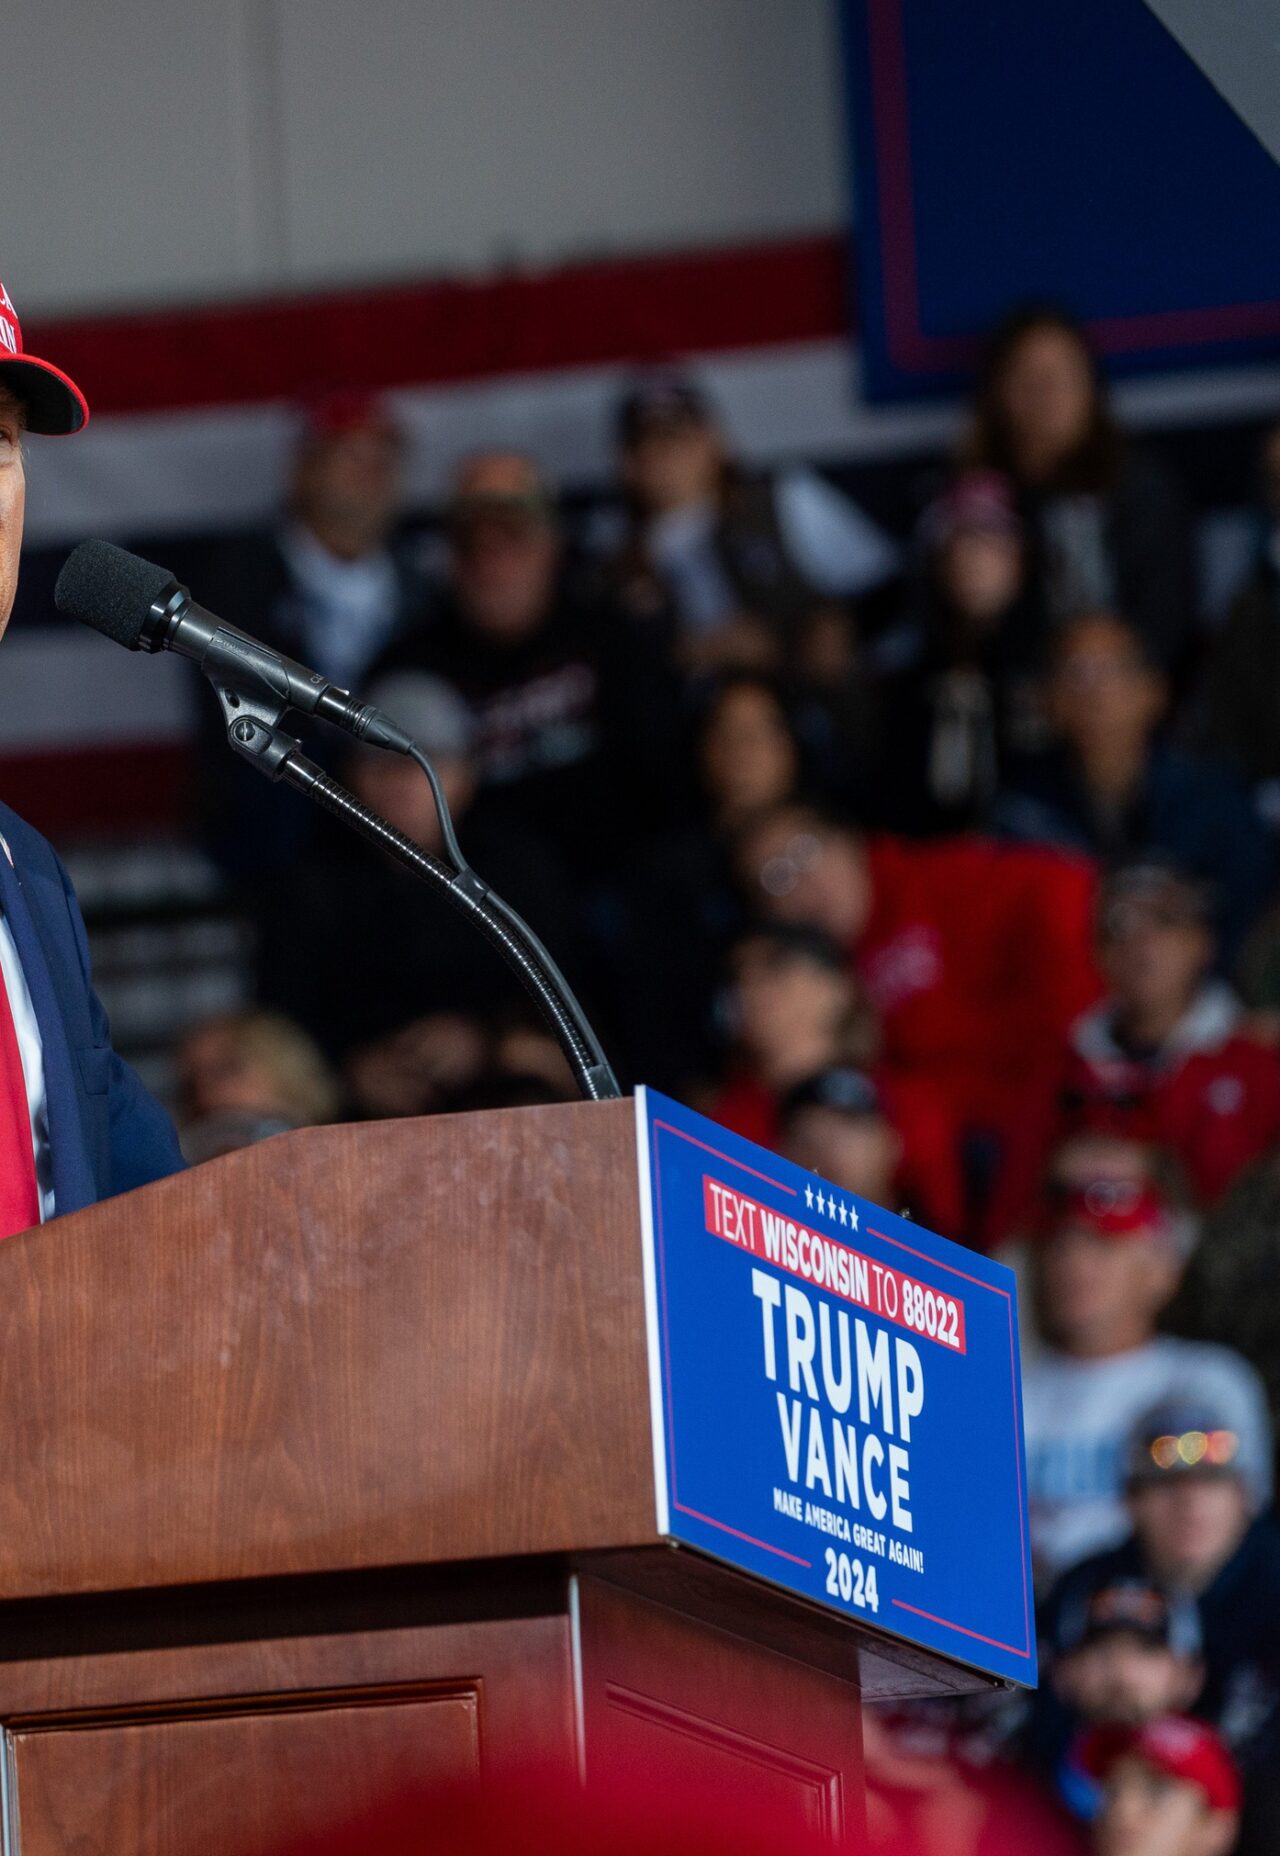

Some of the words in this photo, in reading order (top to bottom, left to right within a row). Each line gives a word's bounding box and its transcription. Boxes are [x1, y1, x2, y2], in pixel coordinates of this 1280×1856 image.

[709, 1182, 757, 1250] TEXT
[760, 1209, 870, 1306] WISCONSIN
[872, 1264, 898, 1319] TO
[902, 1279, 960, 1349] 88022
[752, 1267, 924, 1442] TRUMP
[773, 1486, 803, 1523] MAKE
[805, 1501, 851, 1543] AMERICA
[853, 1523, 886, 1558] GREAT
[888, 1538, 925, 1575] AGAIN!
[776, 1391, 913, 1533] VANCE
[824, 1546, 880, 1614] 2024
